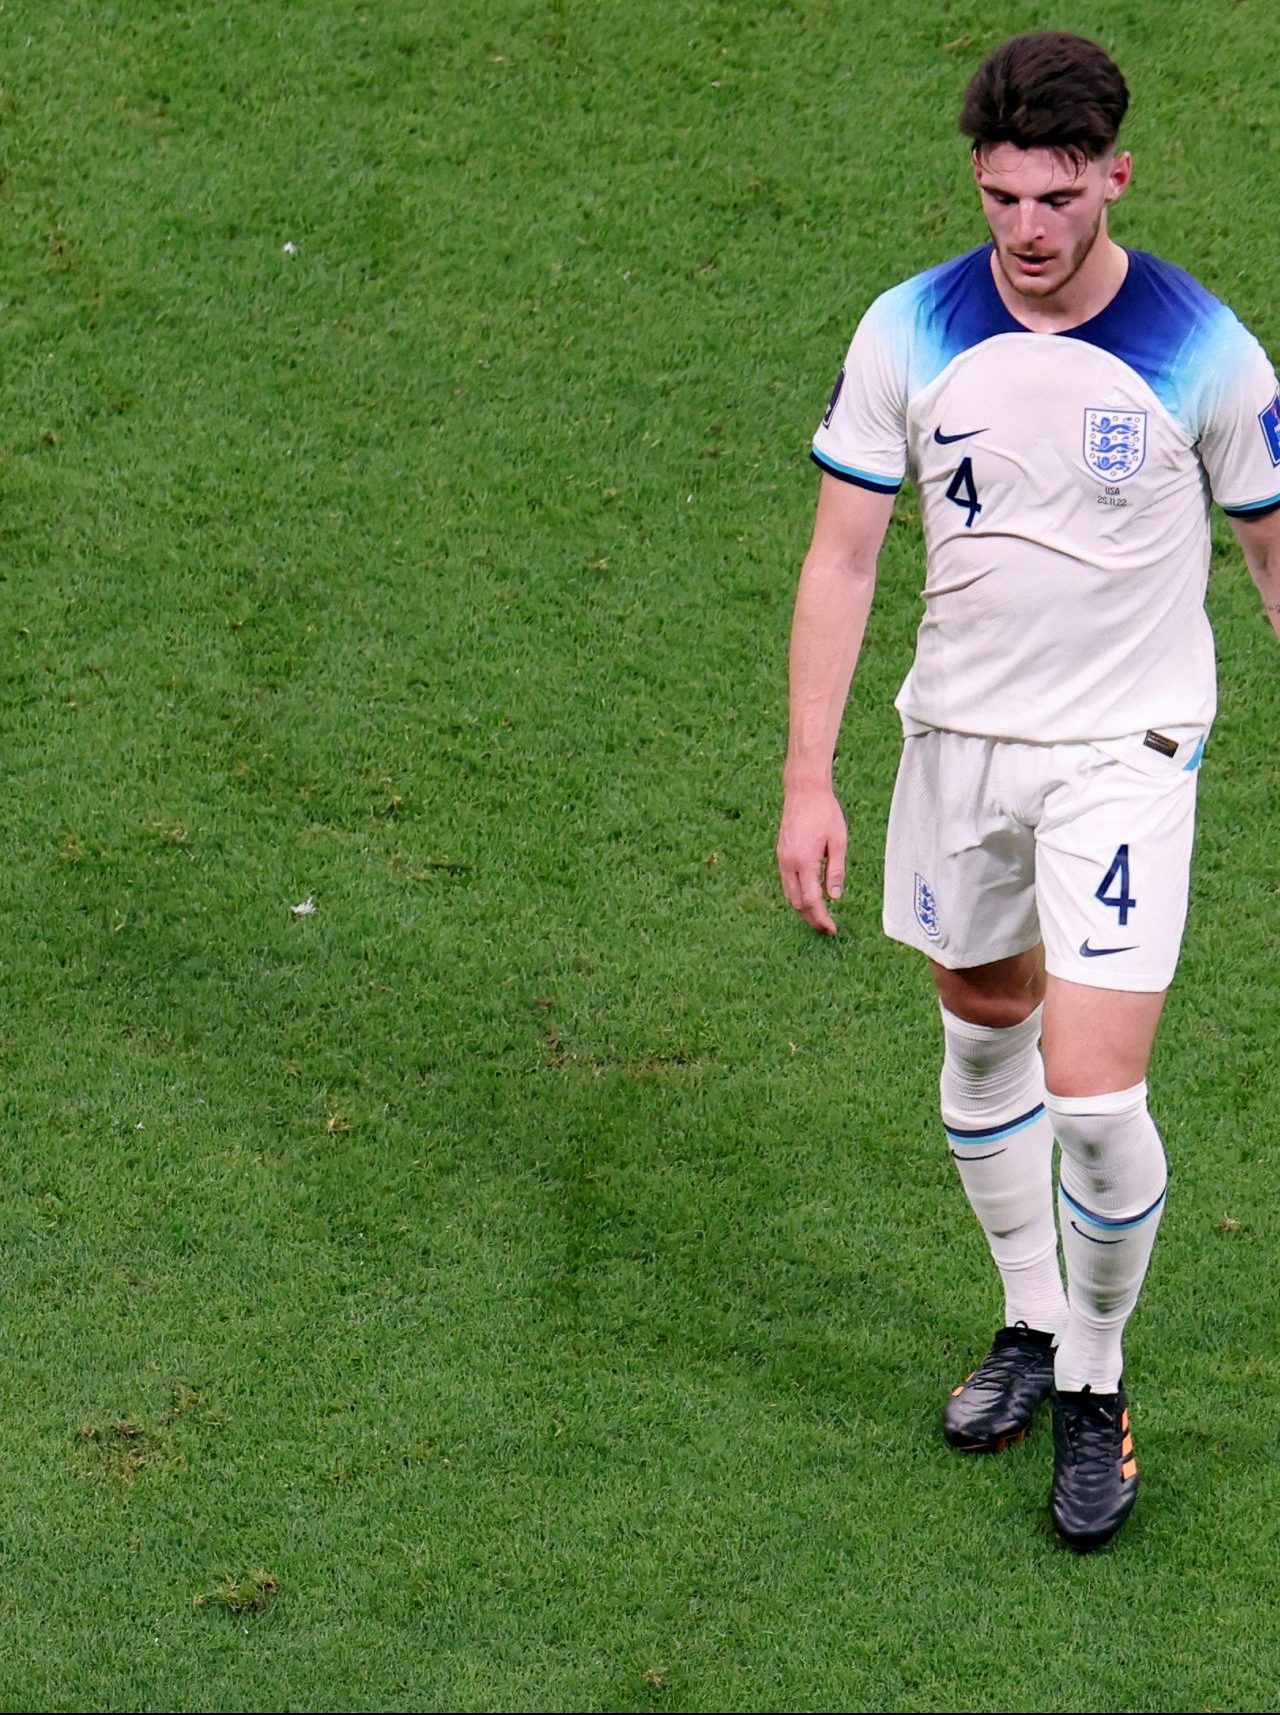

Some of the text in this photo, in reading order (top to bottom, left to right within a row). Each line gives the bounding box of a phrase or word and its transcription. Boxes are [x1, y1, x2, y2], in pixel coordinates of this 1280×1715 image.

[945, 456, 982, 528] 4
[1096, 495, 1128, 507] 25.11.22
[1105, 486, 1120, 496] USA
[1094, 843, 1137, 926] 4
